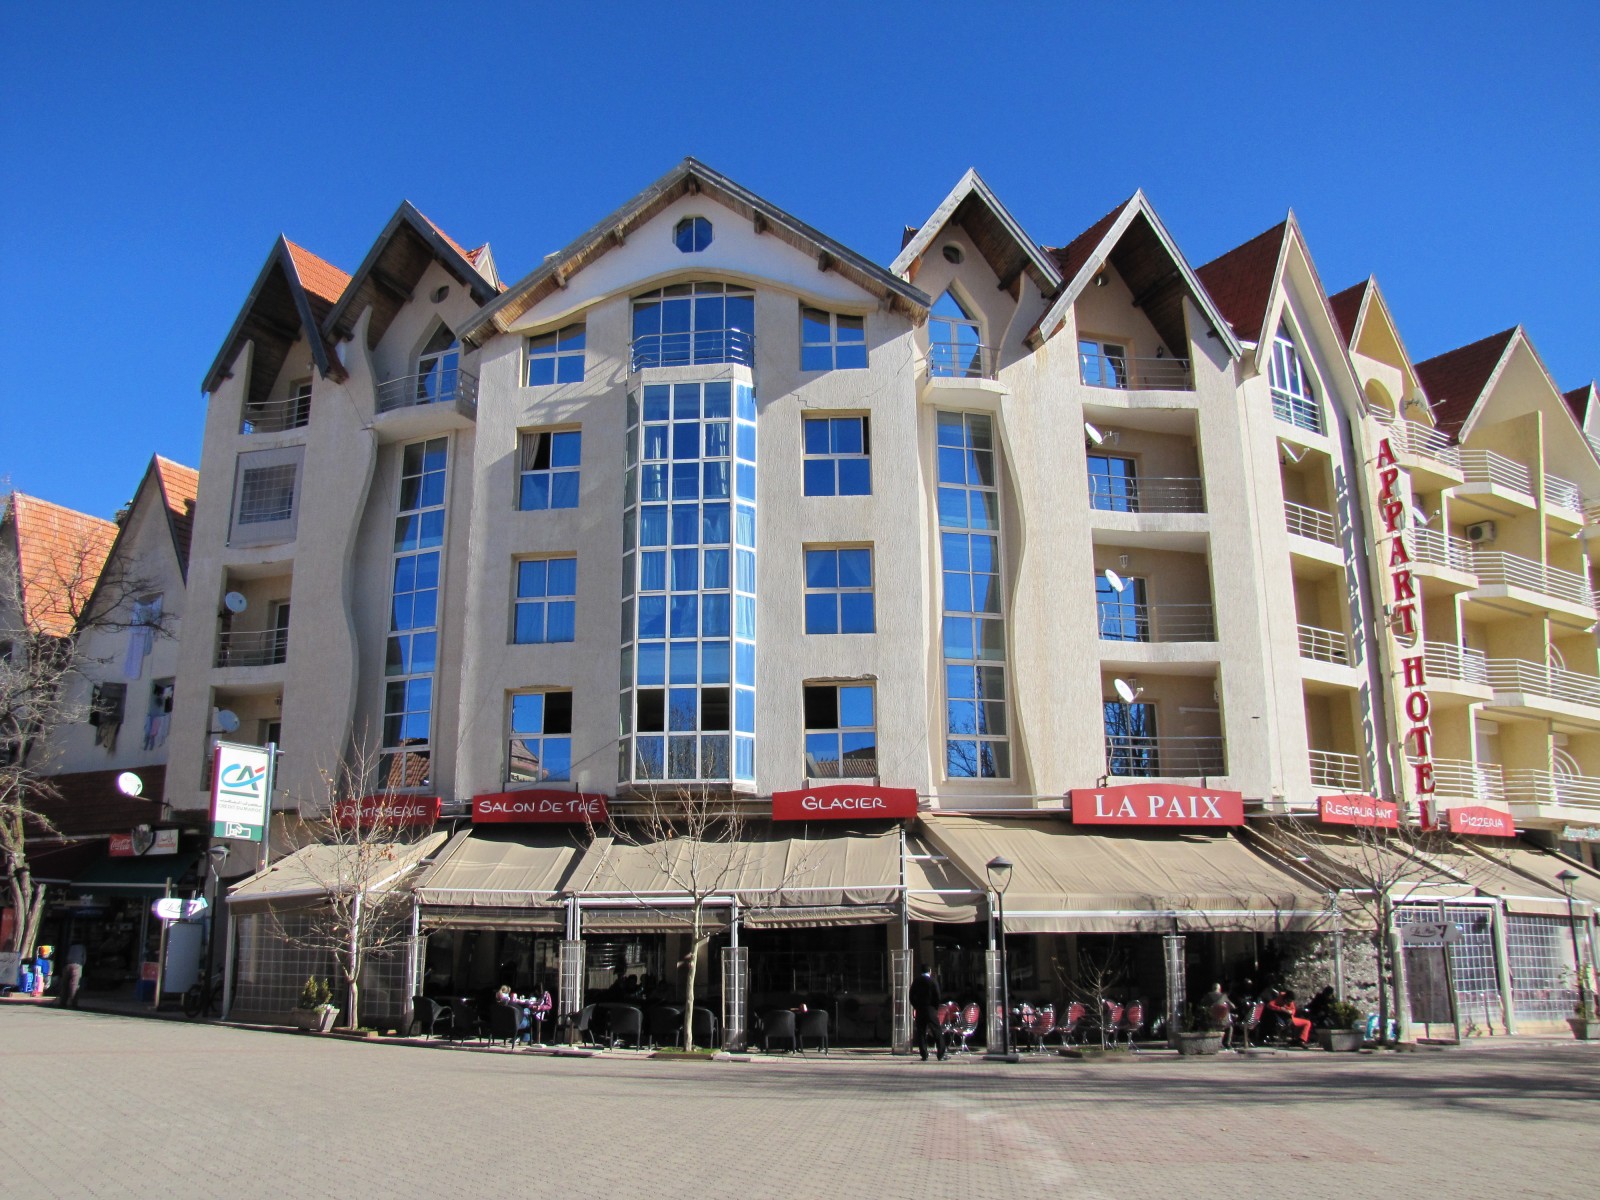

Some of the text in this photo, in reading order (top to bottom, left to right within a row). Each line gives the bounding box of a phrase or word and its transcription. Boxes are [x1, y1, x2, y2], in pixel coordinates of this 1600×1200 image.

[1377, 438, 1416, 635] APPART
[1402, 656, 1439, 832] HOTEL
[478, 799, 600, 813] SALON DE THÉ
[801, 796, 887, 810] GLACIER
[1094, 794, 1222, 819] LA PAIX
[1325, 800, 1393, 819] RESTAURANT
[1460, 813, 1504, 828] PIZZERIA
